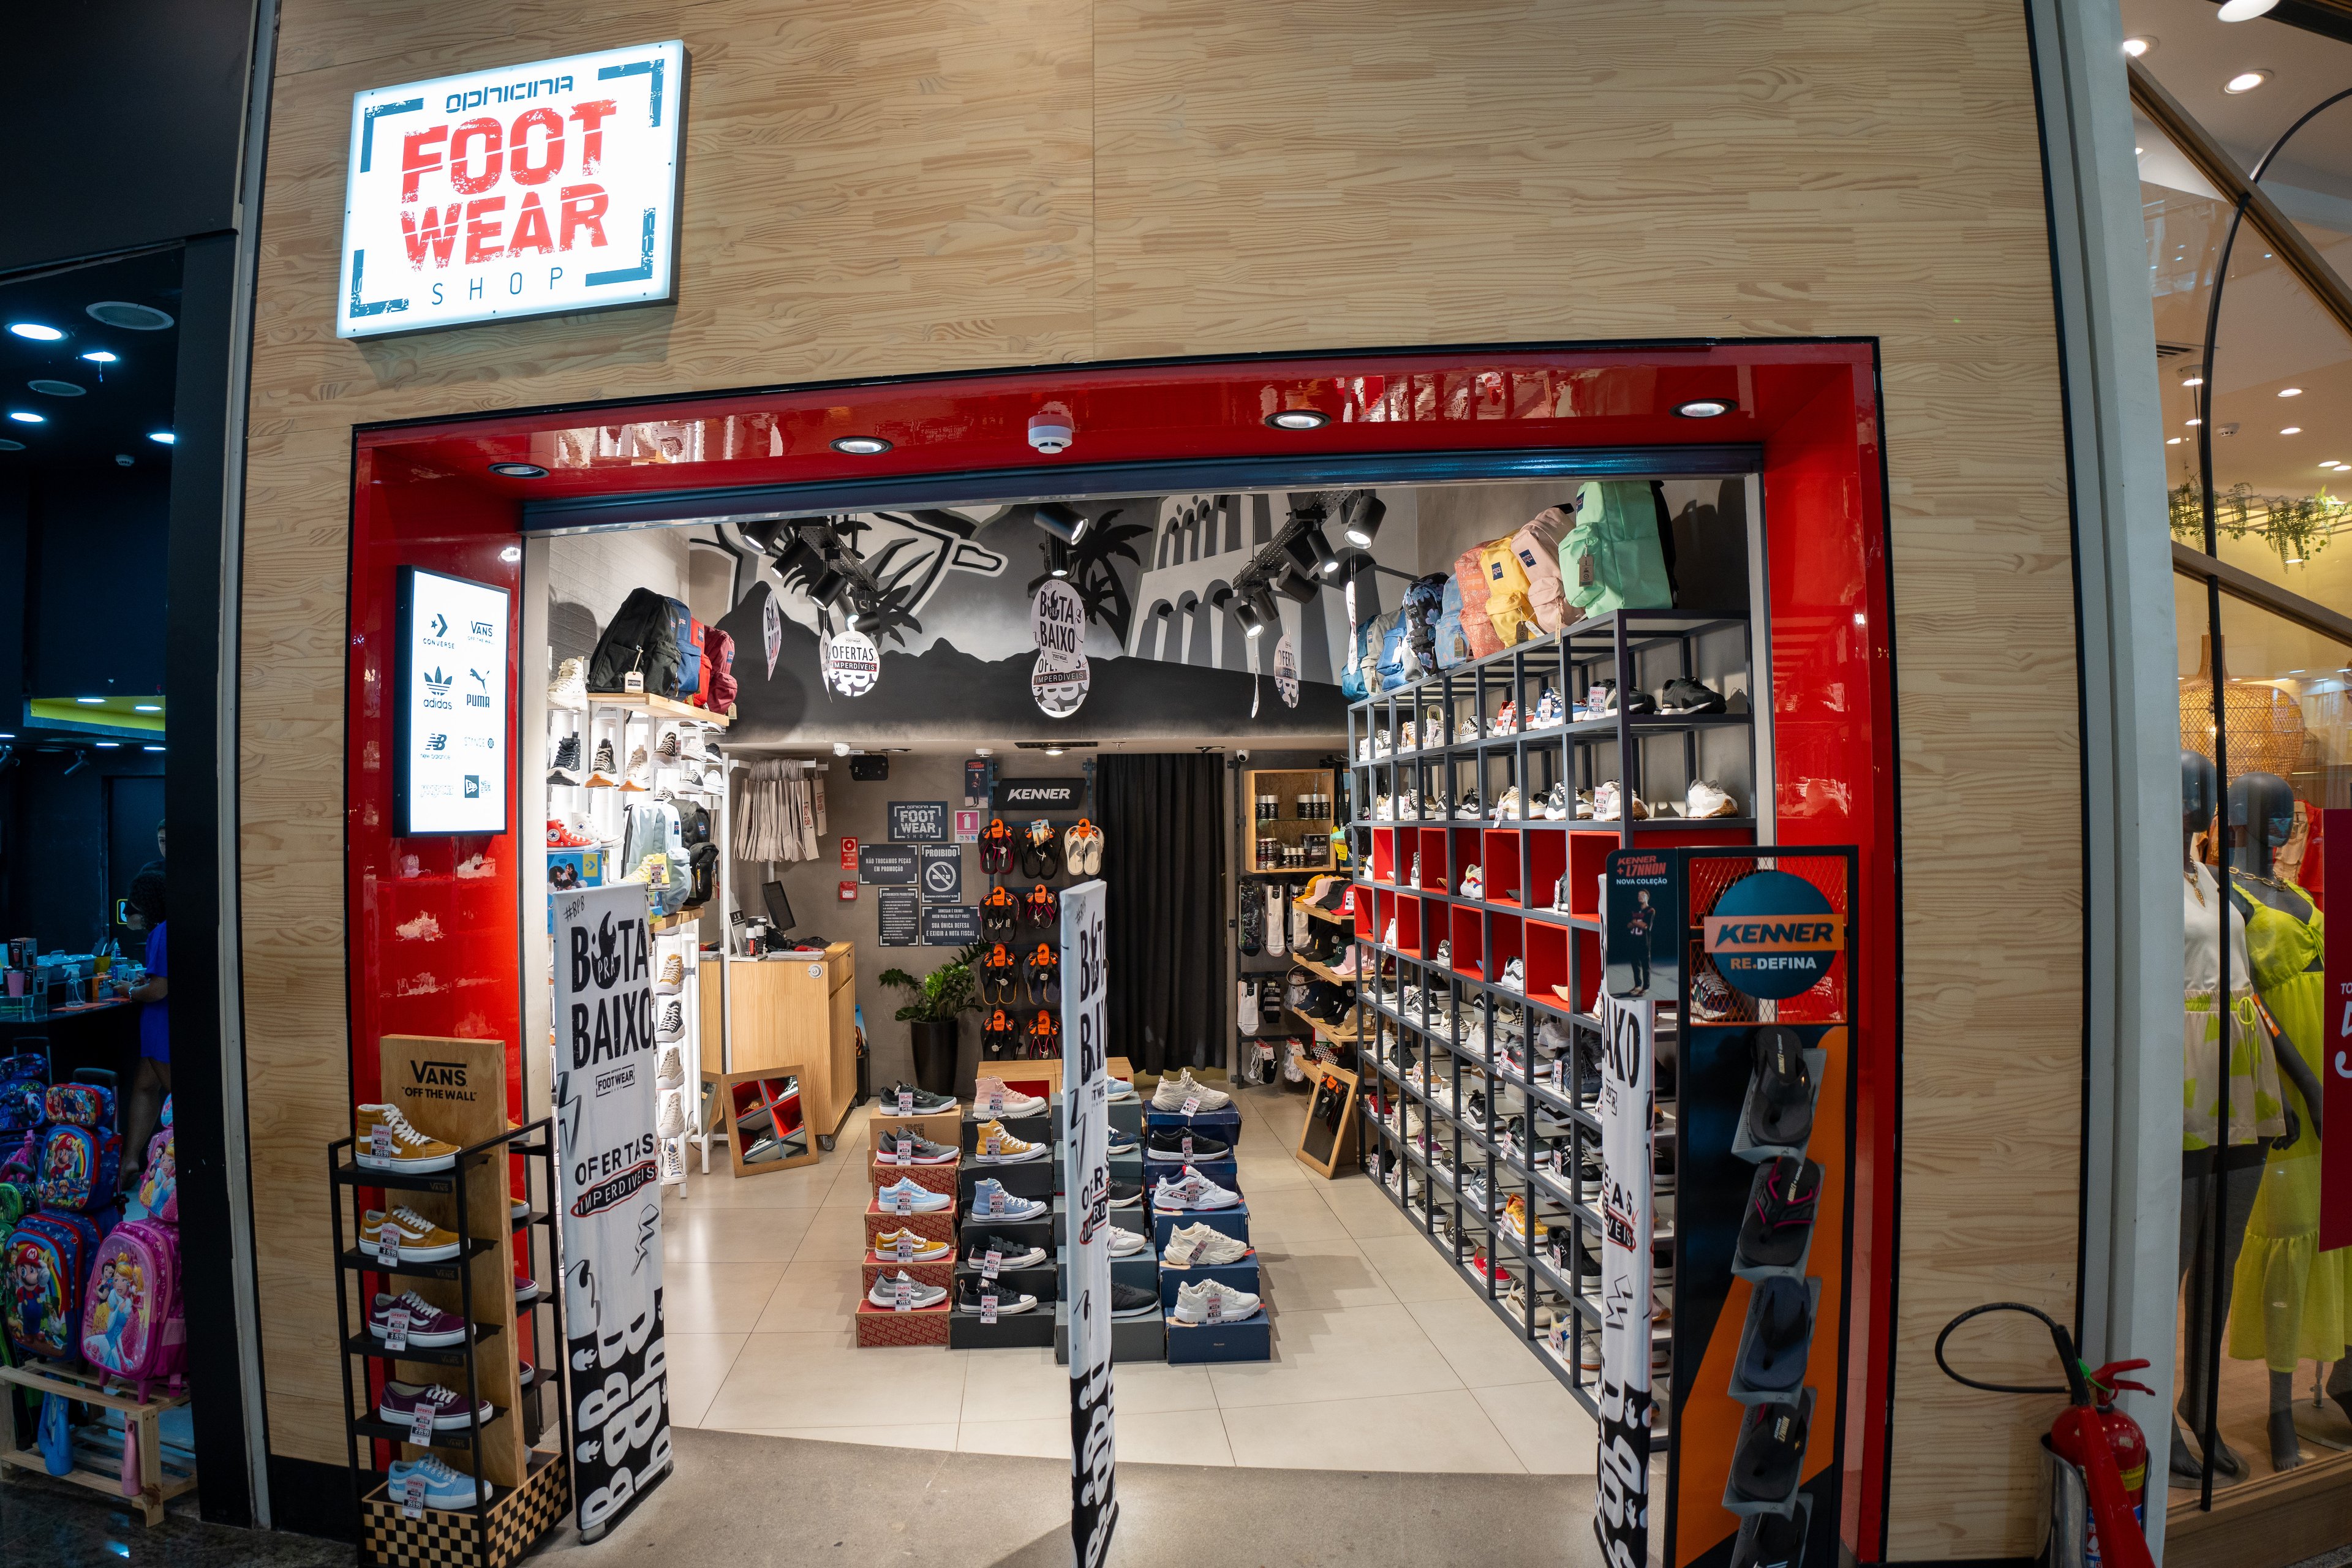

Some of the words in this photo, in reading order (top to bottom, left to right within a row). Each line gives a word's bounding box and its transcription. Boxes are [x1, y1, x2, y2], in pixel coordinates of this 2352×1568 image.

[402, 99, 617, 203] FOOT
[400, 183, 609, 272] WEAR
[431, 267, 563, 305] SHOP
[470, 620, 493, 637] VANS
[1040, 620, 1075, 654] BAIXO
[423, 638, 454, 649] CONVERSE
[832, 645, 874, 662] OFERTAS
[1035, 671, 1084, 684] IMPERDÍVEIS
[423, 698, 452, 710] adidas
[467, 694, 489, 708] PUMA
[1008, 788, 1071, 802] KENNER
[900, 810, 936, 823] FOOT
[900, 823, 936, 833] WEAR
[925, 848, 957, 858] PROIBIDO
[1617, 855, 1657, 866] KENNER
[1636, 877, 1668, 886] COLEÇÃO
[1715, 922, 1834, 948] KENNER
[573, 987, 654, 1071] BAIXO
[410, 1060, 467, 1087] VANS
[424, 1088, 443, 1099] THE
[575, 1133, 654, 1186] OFERTAS
[430, 1182, 448, 1191] VANS
[872, 1322, 886, 1332] VANS
[882, 1317, 896, 1329] VANS
[892, 1316, 906, 1326] VANS
[917, 1319, 932, 1329] VANS
[927, 1316, 941, 1326] VANS
[876, 1331, 892, 1341] VANS
[887, 1327, 902, 1338] VANS
[922, 1328, 937, 1338] VANS
